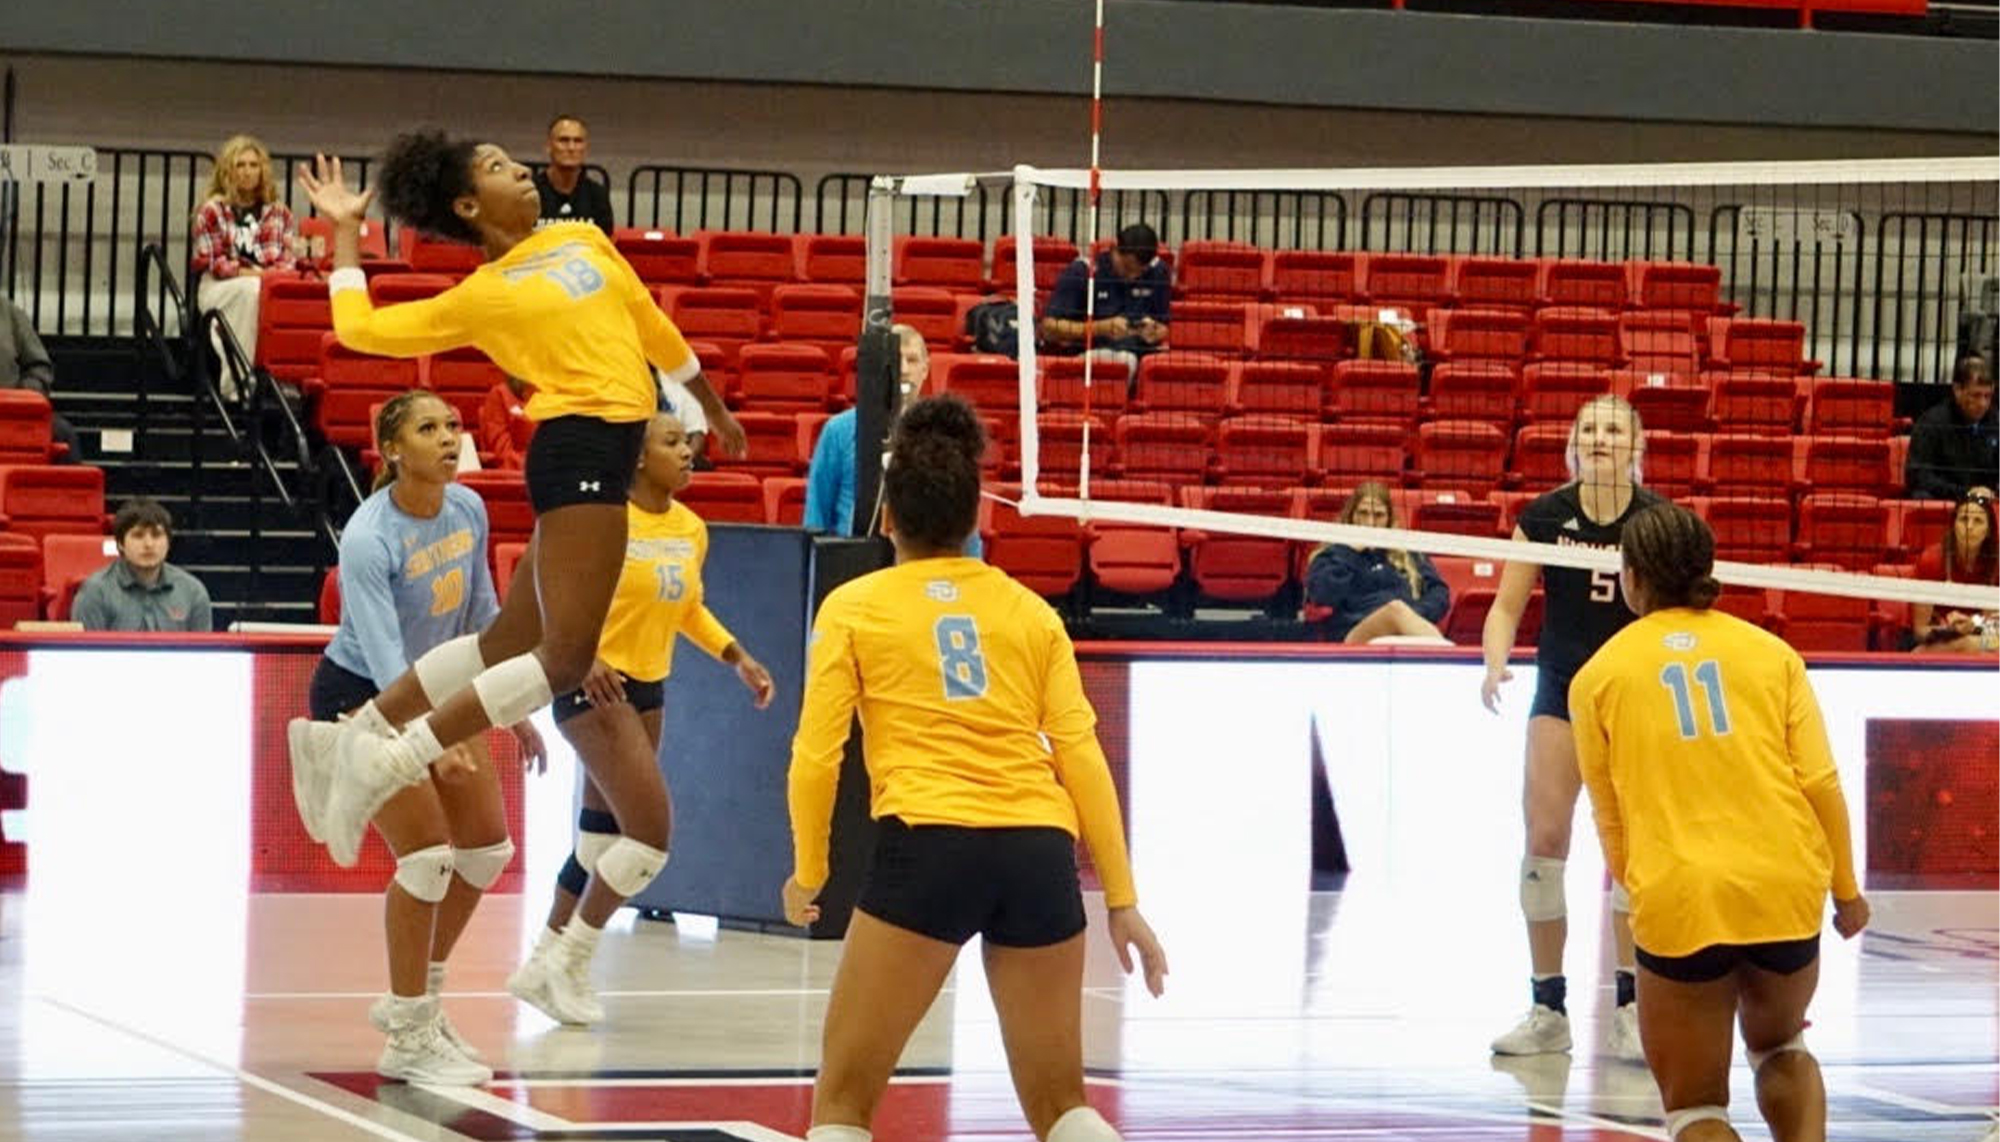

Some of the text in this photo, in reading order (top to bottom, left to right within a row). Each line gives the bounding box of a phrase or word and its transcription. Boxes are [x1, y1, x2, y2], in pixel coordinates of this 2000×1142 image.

[546, 259, 606, 302] 18
[656, 563, 686, 603] 15
[1590, 565, 1615, 602] 5
[932, 614, 988, 701] 8
[1659, 658, 1733, 741] 11
